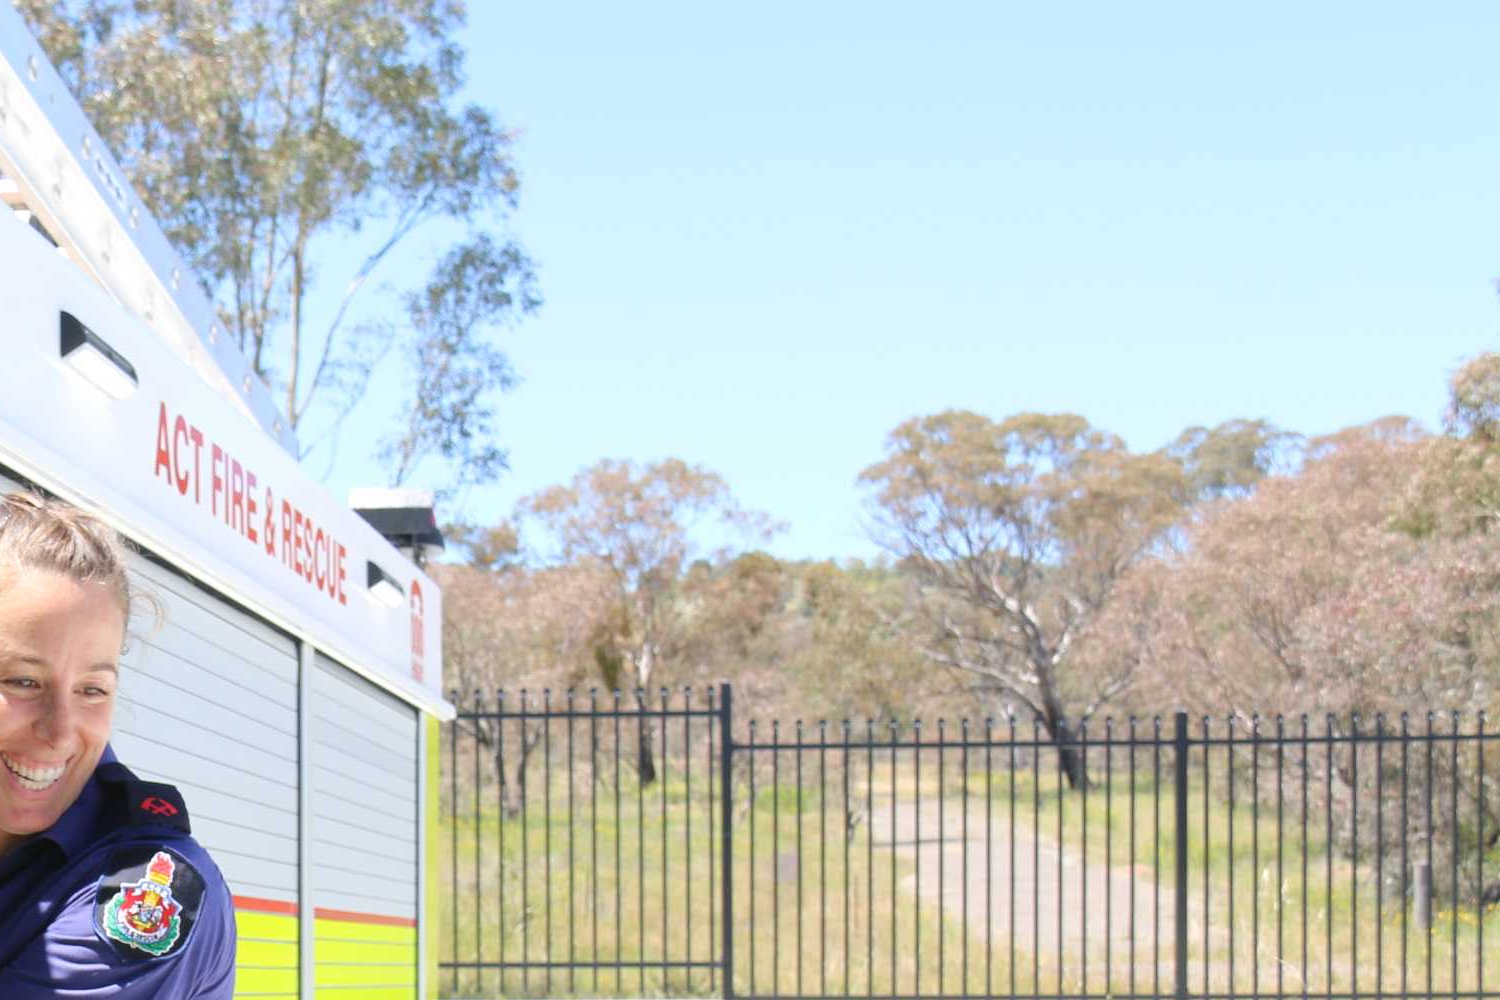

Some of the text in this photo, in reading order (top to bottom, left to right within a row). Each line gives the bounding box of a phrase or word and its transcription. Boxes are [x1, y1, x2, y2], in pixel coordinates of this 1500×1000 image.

[155, 401, 347, 606] ACT FIRE & RESCUE
